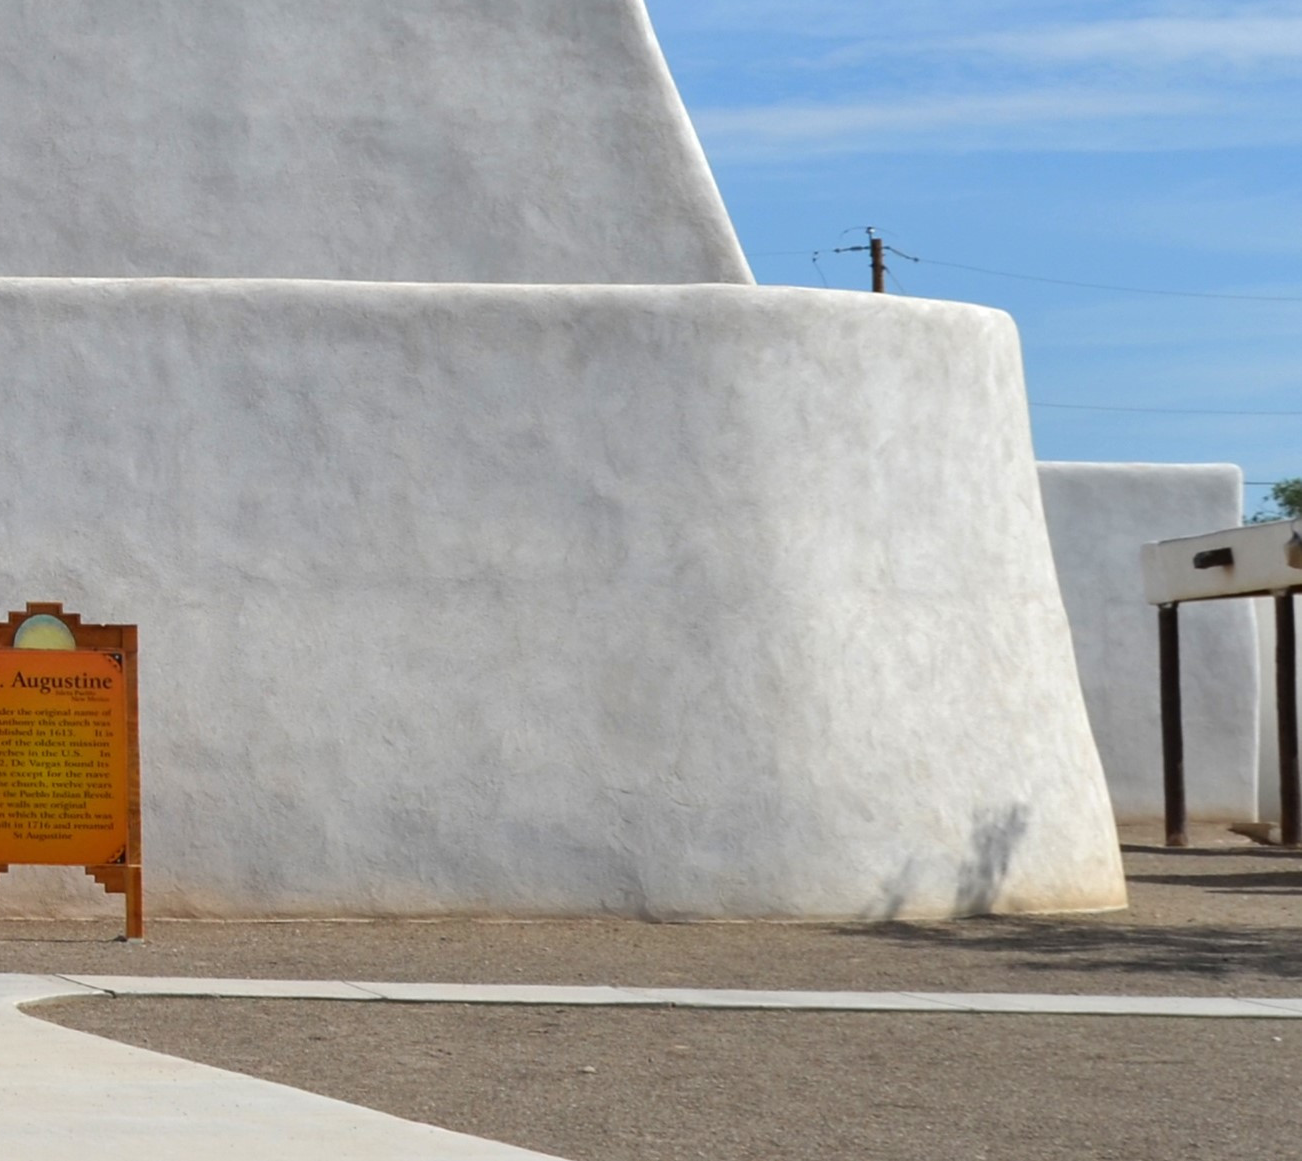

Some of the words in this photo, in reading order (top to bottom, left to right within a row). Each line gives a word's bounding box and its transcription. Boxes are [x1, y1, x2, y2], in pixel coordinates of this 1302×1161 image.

[12, 670, 113, 694] Augustine
[17, 708, 33, 716] the
[35, 709, 71, 717] original
[38, 718, 56, 726] this
[94, 729, 103, 737] It
[15, 739, 31, 747] the
[34, 739, 66, 747] oldest
[69, 739, 110, 747] mission
[28, 749, 38, 757] in
[41, 749, 58, 757] the
[61, 749, 83, 757] U.S.
[11, 759, 25, 767] De
[29, 759, 60, 769] Vargas
[64, 760, 94, 768] found
[97, 760, 109, 768] its
[10, 771, 43, 779] except
[65, 770, 82, 778] the
[51, 780, 83, 788] twelve
[86, 782, 113, 790] years
[3, 790, 17, 798] the
[19, 790, 50, 798] Pueblo
[7, 800, 31, 808] walls
[50, 801, 86, 811] original
[8, 811, 37, 819] which
[40, 811, 56, 819] the
[73, 822, 114, 830] renamed
[26, 831, 73, 841] Augustine
